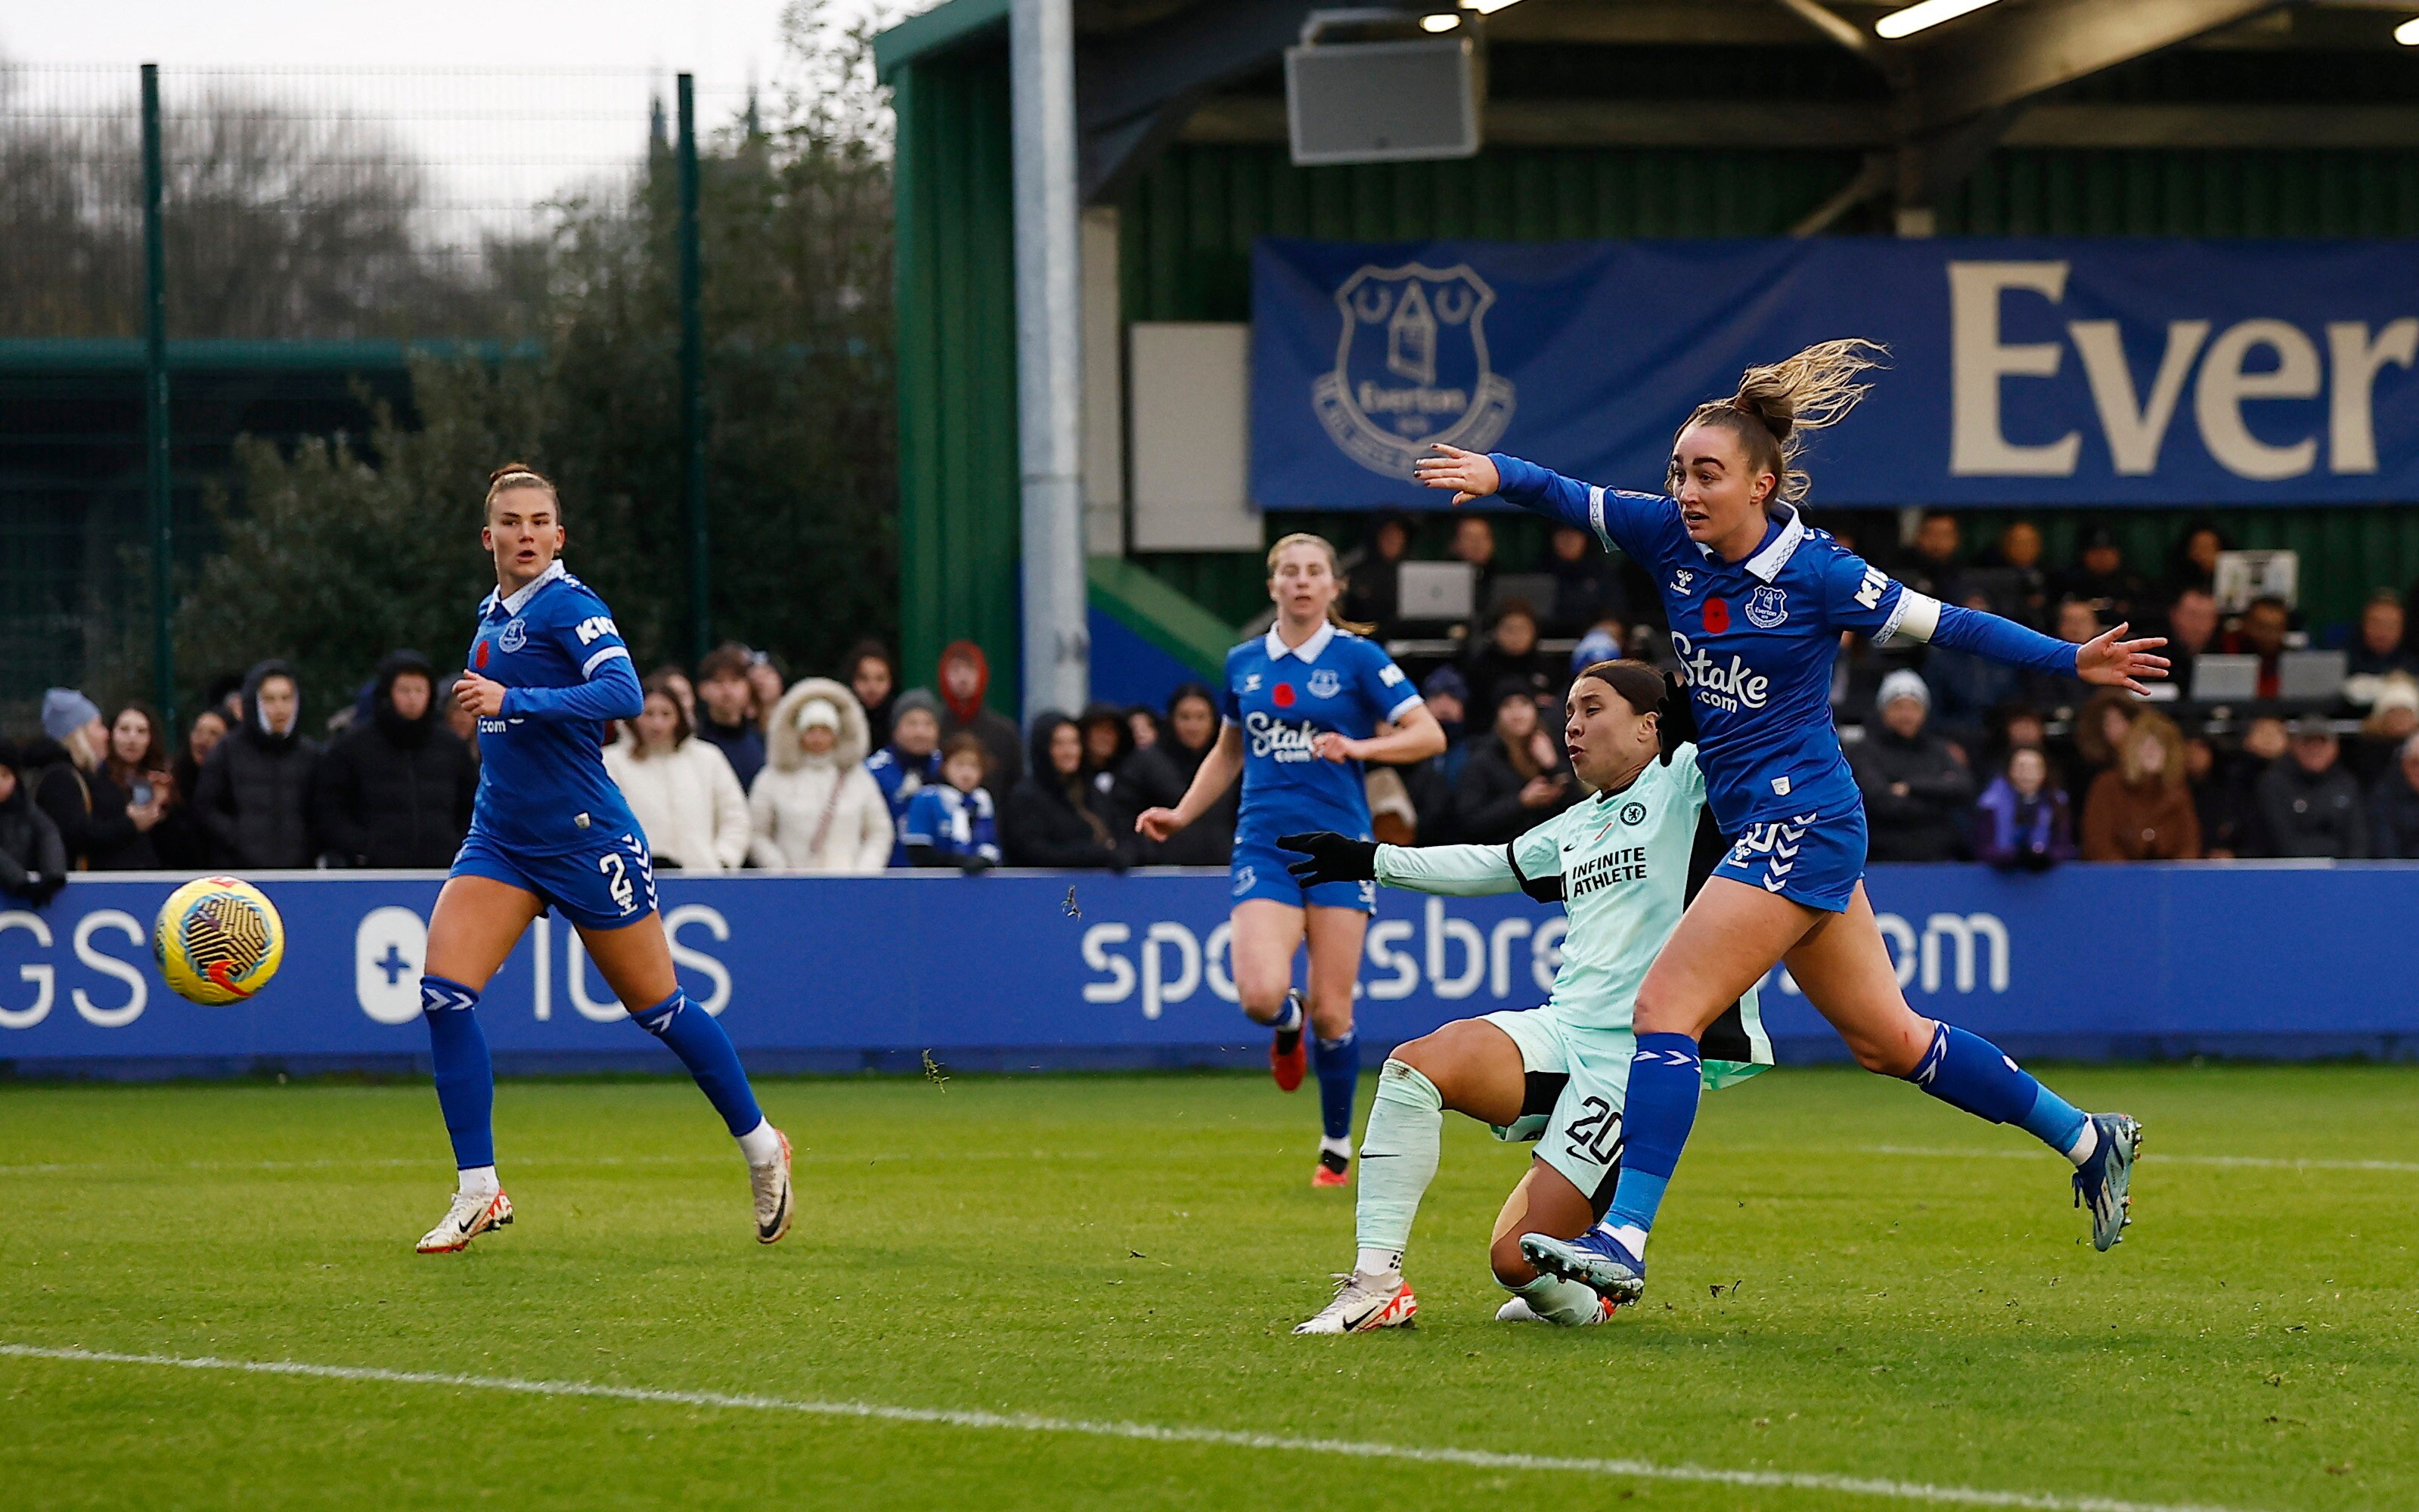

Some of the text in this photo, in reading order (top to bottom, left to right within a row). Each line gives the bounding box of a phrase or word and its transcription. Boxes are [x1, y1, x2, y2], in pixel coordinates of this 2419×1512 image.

[1946, 260, 2419, 482] Ever
[1671, 631, 1769, 708] Stake
[1245, 711, 1320, 758] Stak
[599, 852, 634, 902] 2
[1572, 847, 1646, 880] INFINITE
[1574, 864, 1647, 898] ATHLETE
[1565, 1096, 1624, 1165] 20
